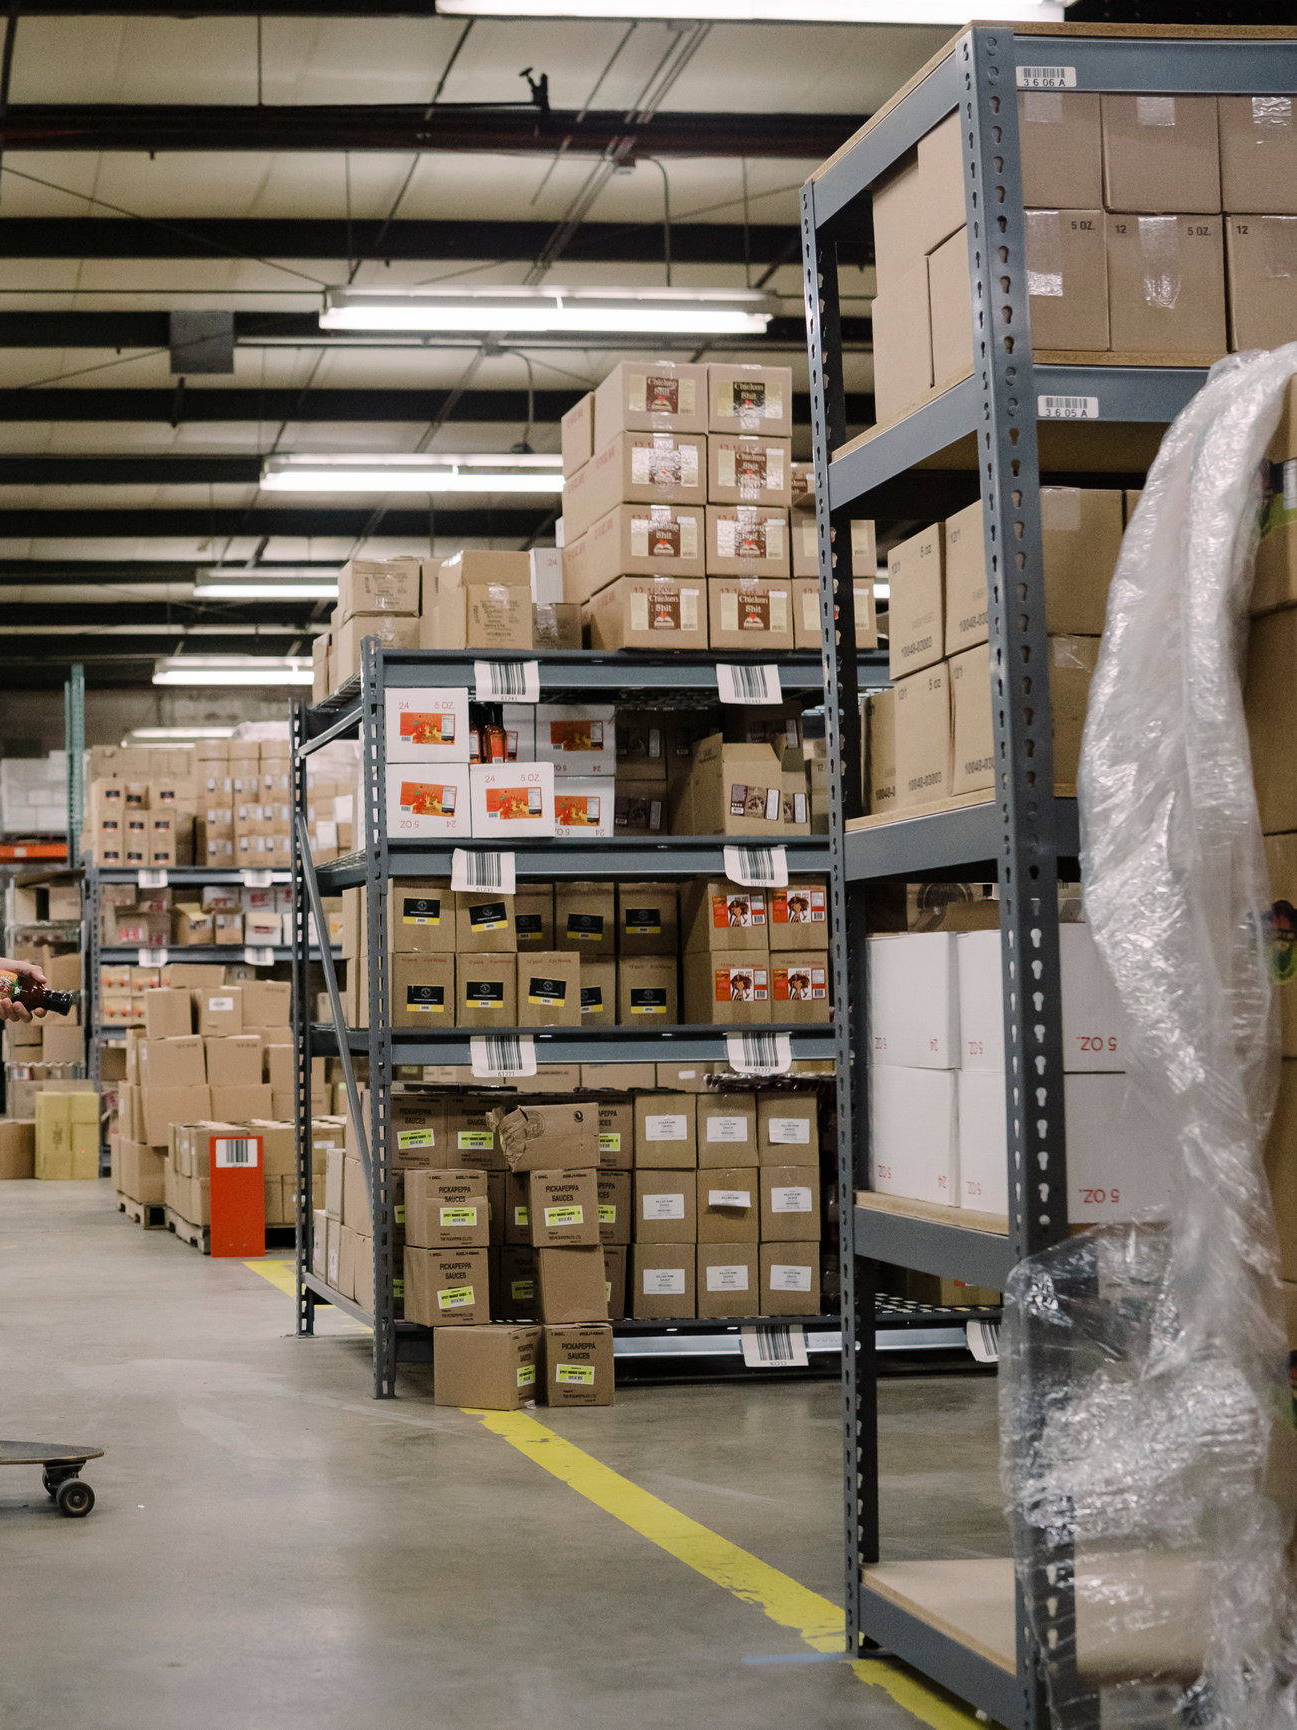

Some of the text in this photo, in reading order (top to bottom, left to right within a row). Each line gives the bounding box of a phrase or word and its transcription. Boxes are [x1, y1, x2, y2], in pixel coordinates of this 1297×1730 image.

[1071, 221, 1077, 230] 5
[1115, 225, 1126, 234] 12
[1187, 227, 1193, 235] 5
[1236, 226, 1248, 234] 12
[648, 594, 678, 603] Chicken
[738, 595, 768, 604] Chicken
[655, 604, 672, 612] Shit
[745, 605, 762, 613] Shit
[399, 701, 409, 710] 24
[485, 776, 495, 784] 24
[414, 820, 419, 828] 5
[445, 820, 456, 828] 24
[1108, 1037, 1117, 1052] 5
[439, 1186, 471, 1194] PICKAPEPPA
[545, 1185, 579, 1193] PICKAPEPPA
[552, 1194, 574, 1202] SAUCES
[1110, 1189, 1119, 1203] 5
[440, 1263, 472, 1271] PICKAPEPPA
[446, 1272, 466, 1280] SAUCES
[567, 1352, 590, 1360] SAUCES
